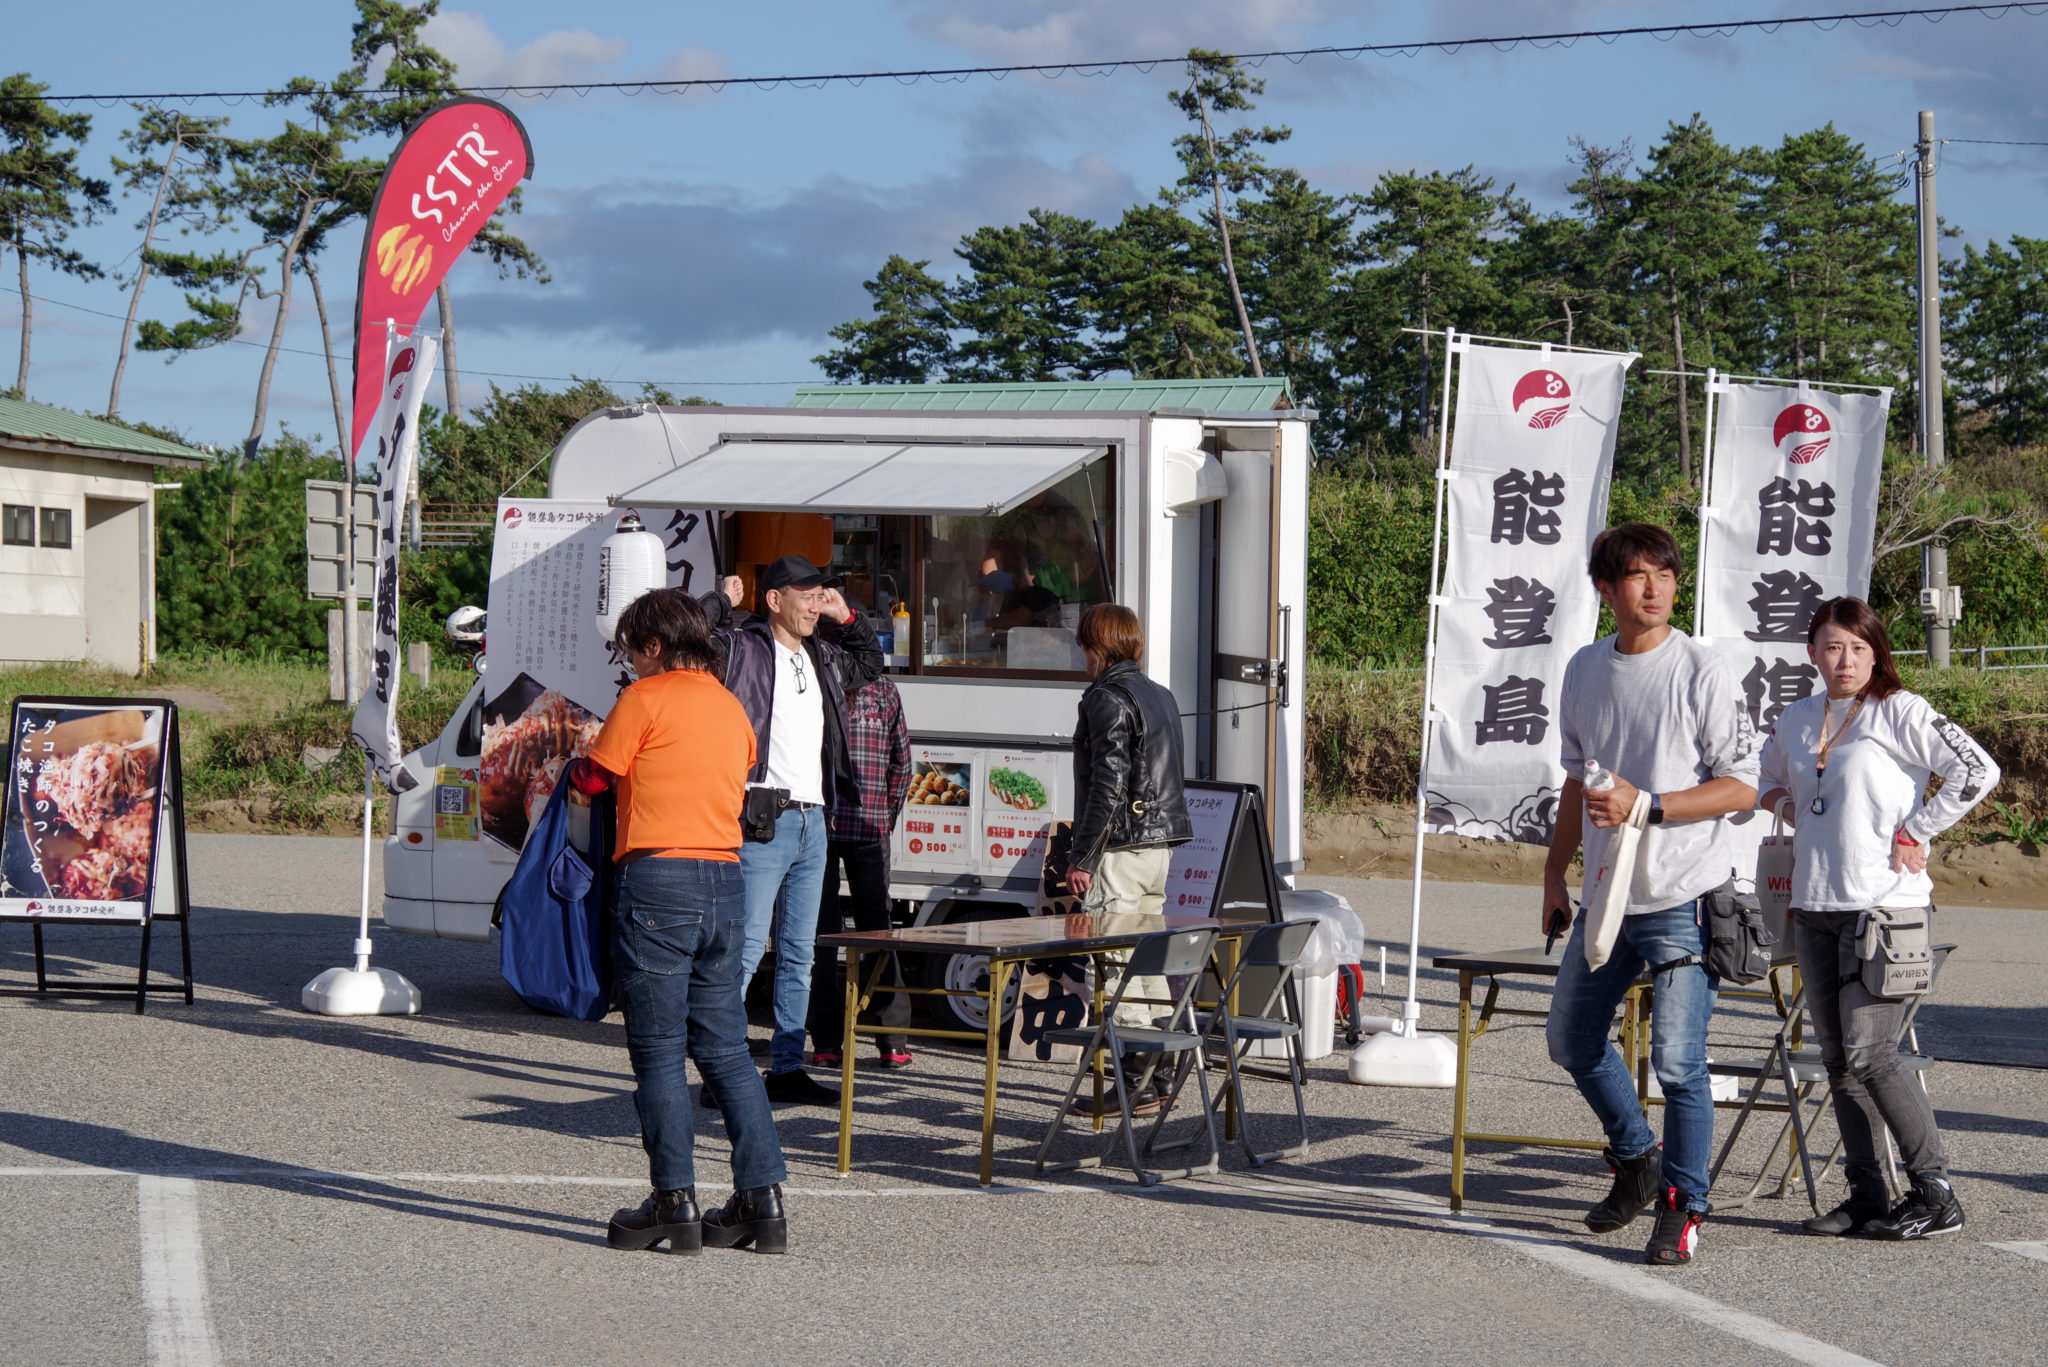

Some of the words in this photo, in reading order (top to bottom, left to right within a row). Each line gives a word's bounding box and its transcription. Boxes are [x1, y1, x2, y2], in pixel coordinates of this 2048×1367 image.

[442, 200, 480, 242] Chasing
[477, 181, 493, 198] the
[491, 159, 513, 181] Sun
[1475, 467, 1565, 746] 能登島
[17, 717, 36, 793] たこ焼き
[30, 719, 56, 873] タコ漁師のつくる
[926, 842, 947, 852] 500
[1007, 847, 1027, 856] 600
[1193, 870, 1208, 880] 500
[1187, 895, 1202, 904] 500
[1890, 968, 1929, 978] AVIREX
